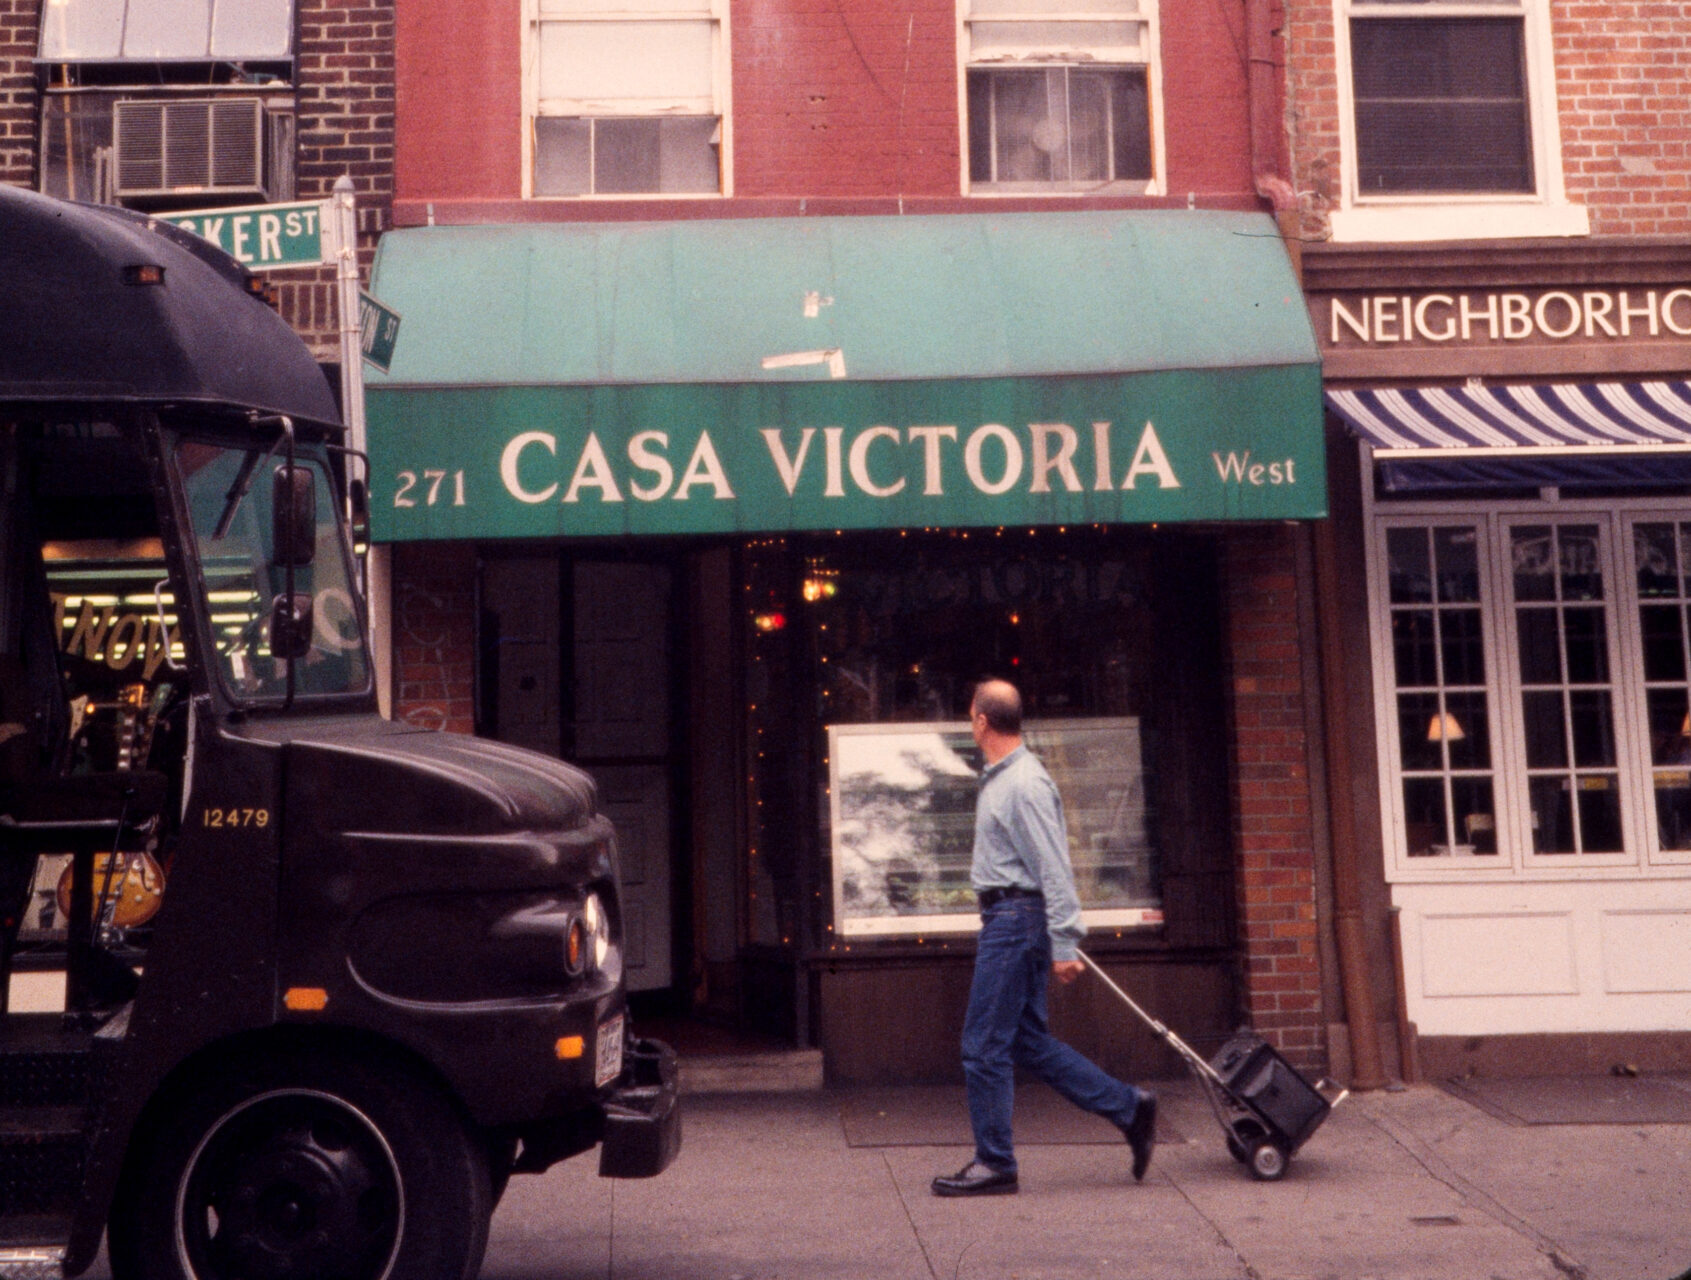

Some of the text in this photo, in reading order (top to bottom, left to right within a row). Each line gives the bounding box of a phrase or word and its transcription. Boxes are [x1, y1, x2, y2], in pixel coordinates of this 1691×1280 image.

[178, 210, 318, 263] KER ST
[1330, 288, 1691, 342] NEIGHBORHO
[393, 420, 1297, 508] 271 CASA VICTORIA West
[203, 808, 269, 828] 12479
